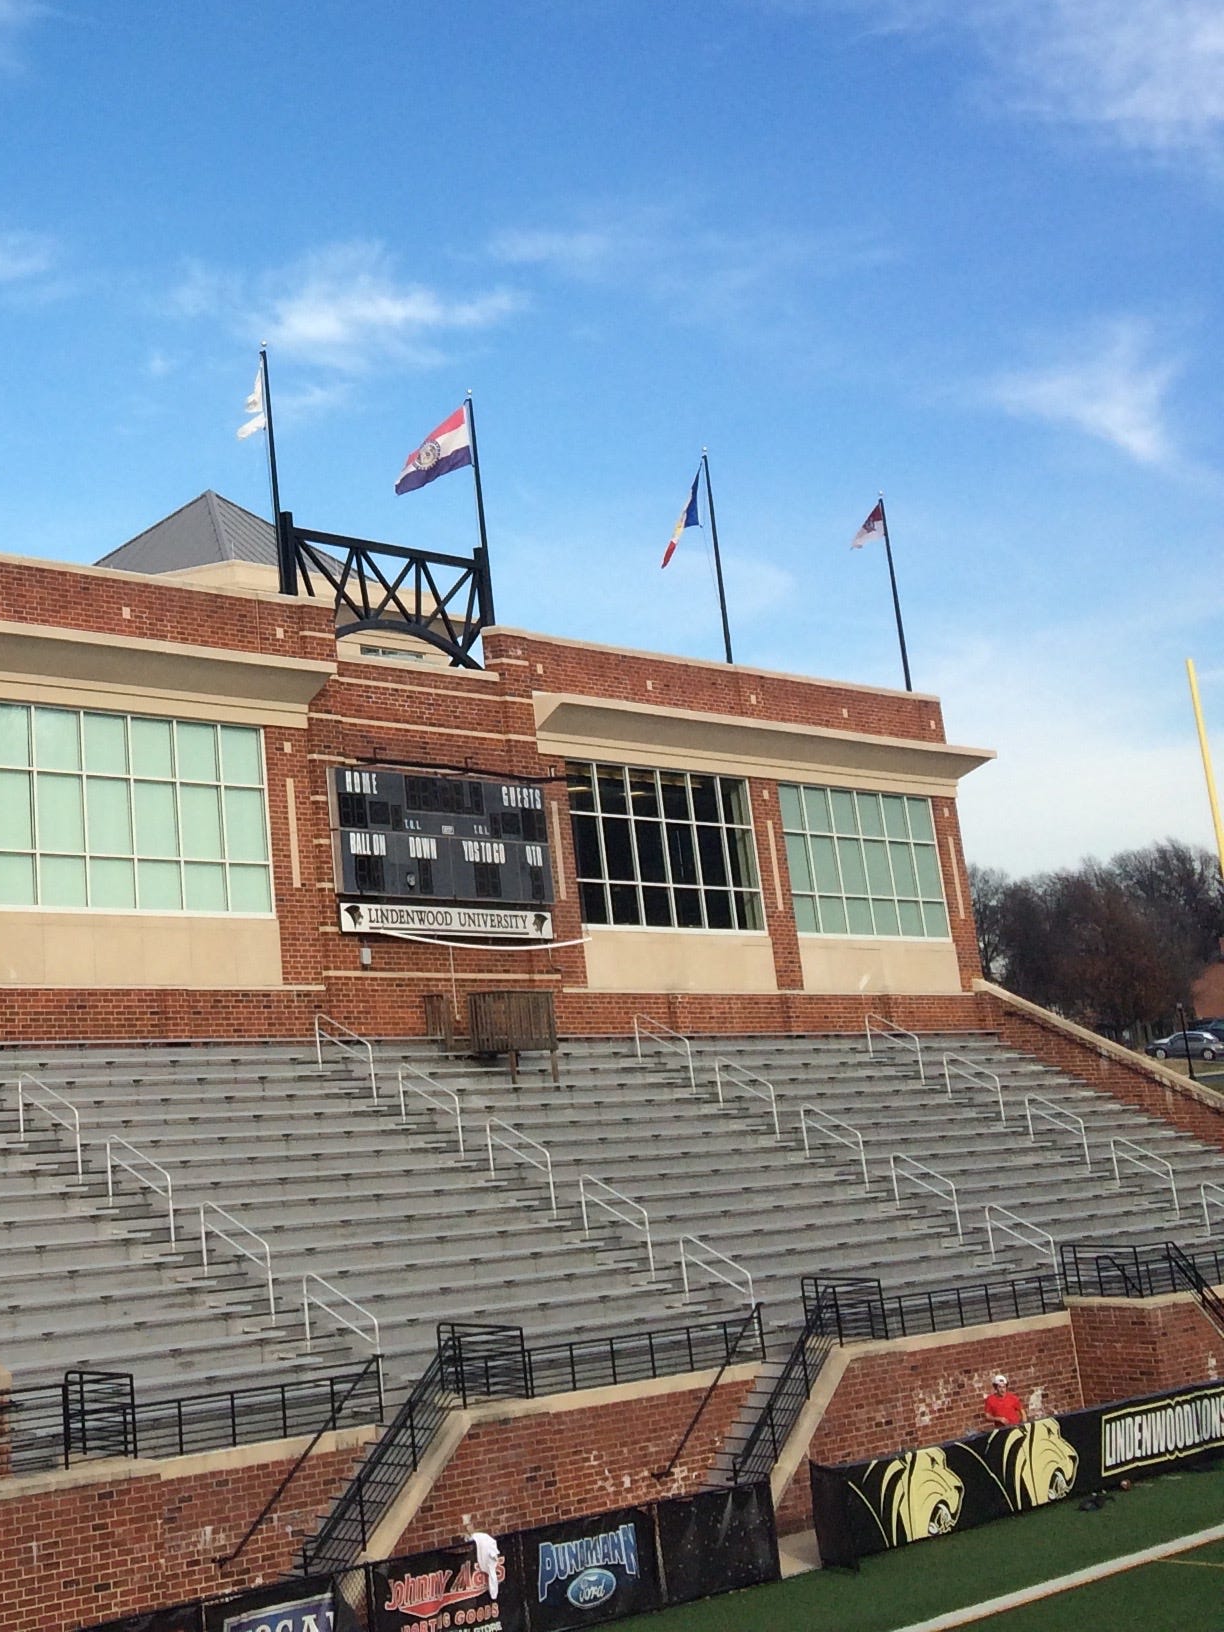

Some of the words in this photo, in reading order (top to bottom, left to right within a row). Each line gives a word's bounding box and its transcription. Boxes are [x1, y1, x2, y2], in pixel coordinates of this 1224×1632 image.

[345, 770, 378, 795] HOME
[501, 785, 542, 810] GUESTS
[349, 832, 372, 856] BALL
[372, 834, 387, 857] ON
[408, 836, 438, 860] DOWN
[461, 840, 480, 863] YDS
[480, 841, 493, 864] TO
[492, 842, 506, 865] GO
[525, 845, 543, 867] QTR
[368, 907, 453, 926] LINDENWOOD
[457, 912, 528, 930] UNIVERSITY
[579, 1575, 606, 1603] Ford
[454, 1602, 499, 1626] GOODS
